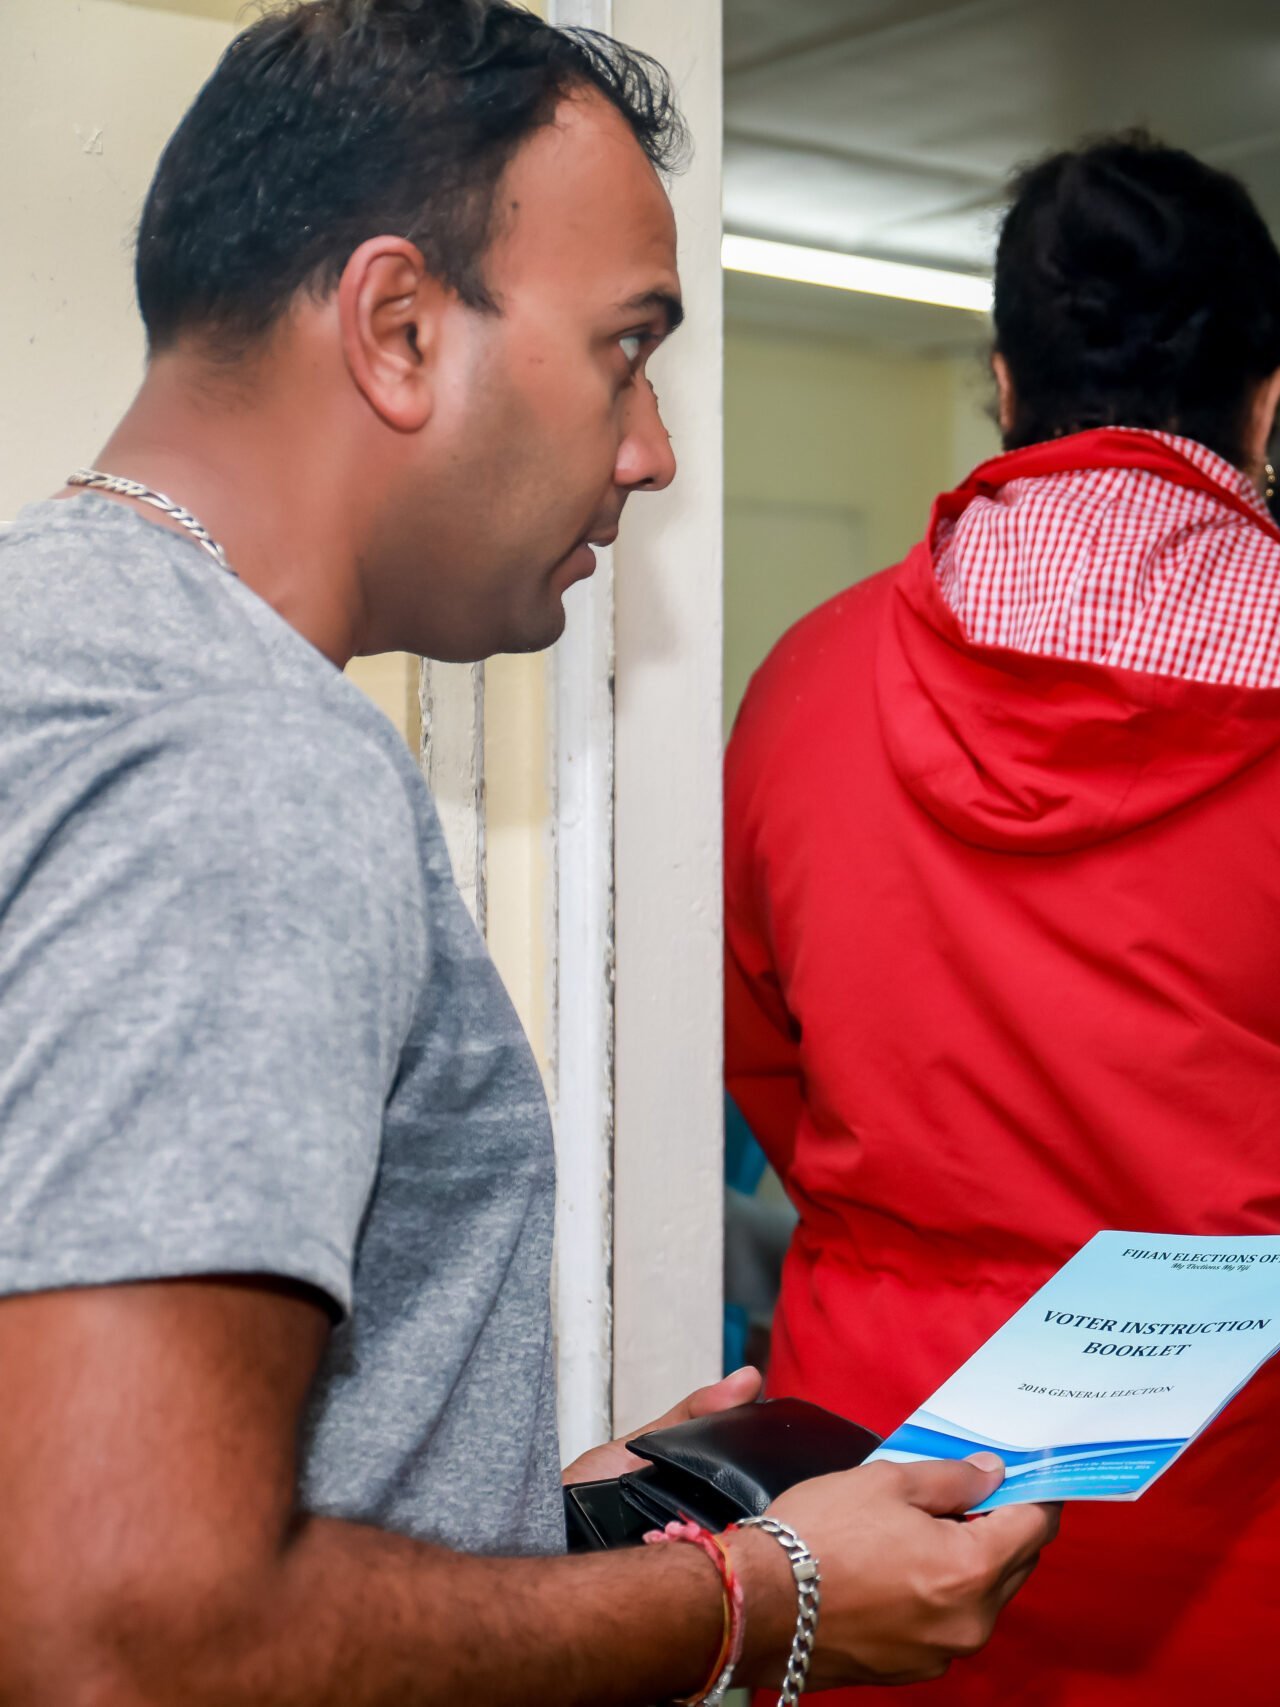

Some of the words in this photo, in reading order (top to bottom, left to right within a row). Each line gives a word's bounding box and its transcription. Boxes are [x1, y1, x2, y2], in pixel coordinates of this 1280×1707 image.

[1121, 1248, 1172, 1261] FIJIAN
[1172, 1252, 1258, 1263] ELECTIONS
[1043, 1310, 1118, 1332] VOTER
[1119, 1318, 1273, 1335] INSTRUCTION
[1082, 1341, 1192, 1357] BOOKLET
[1017, 1382, 1048, 1395] 2018
[1048, 1388, 1108, 1399] GENERAL
[1109, 1385, 1175, 1398] ELECTION
